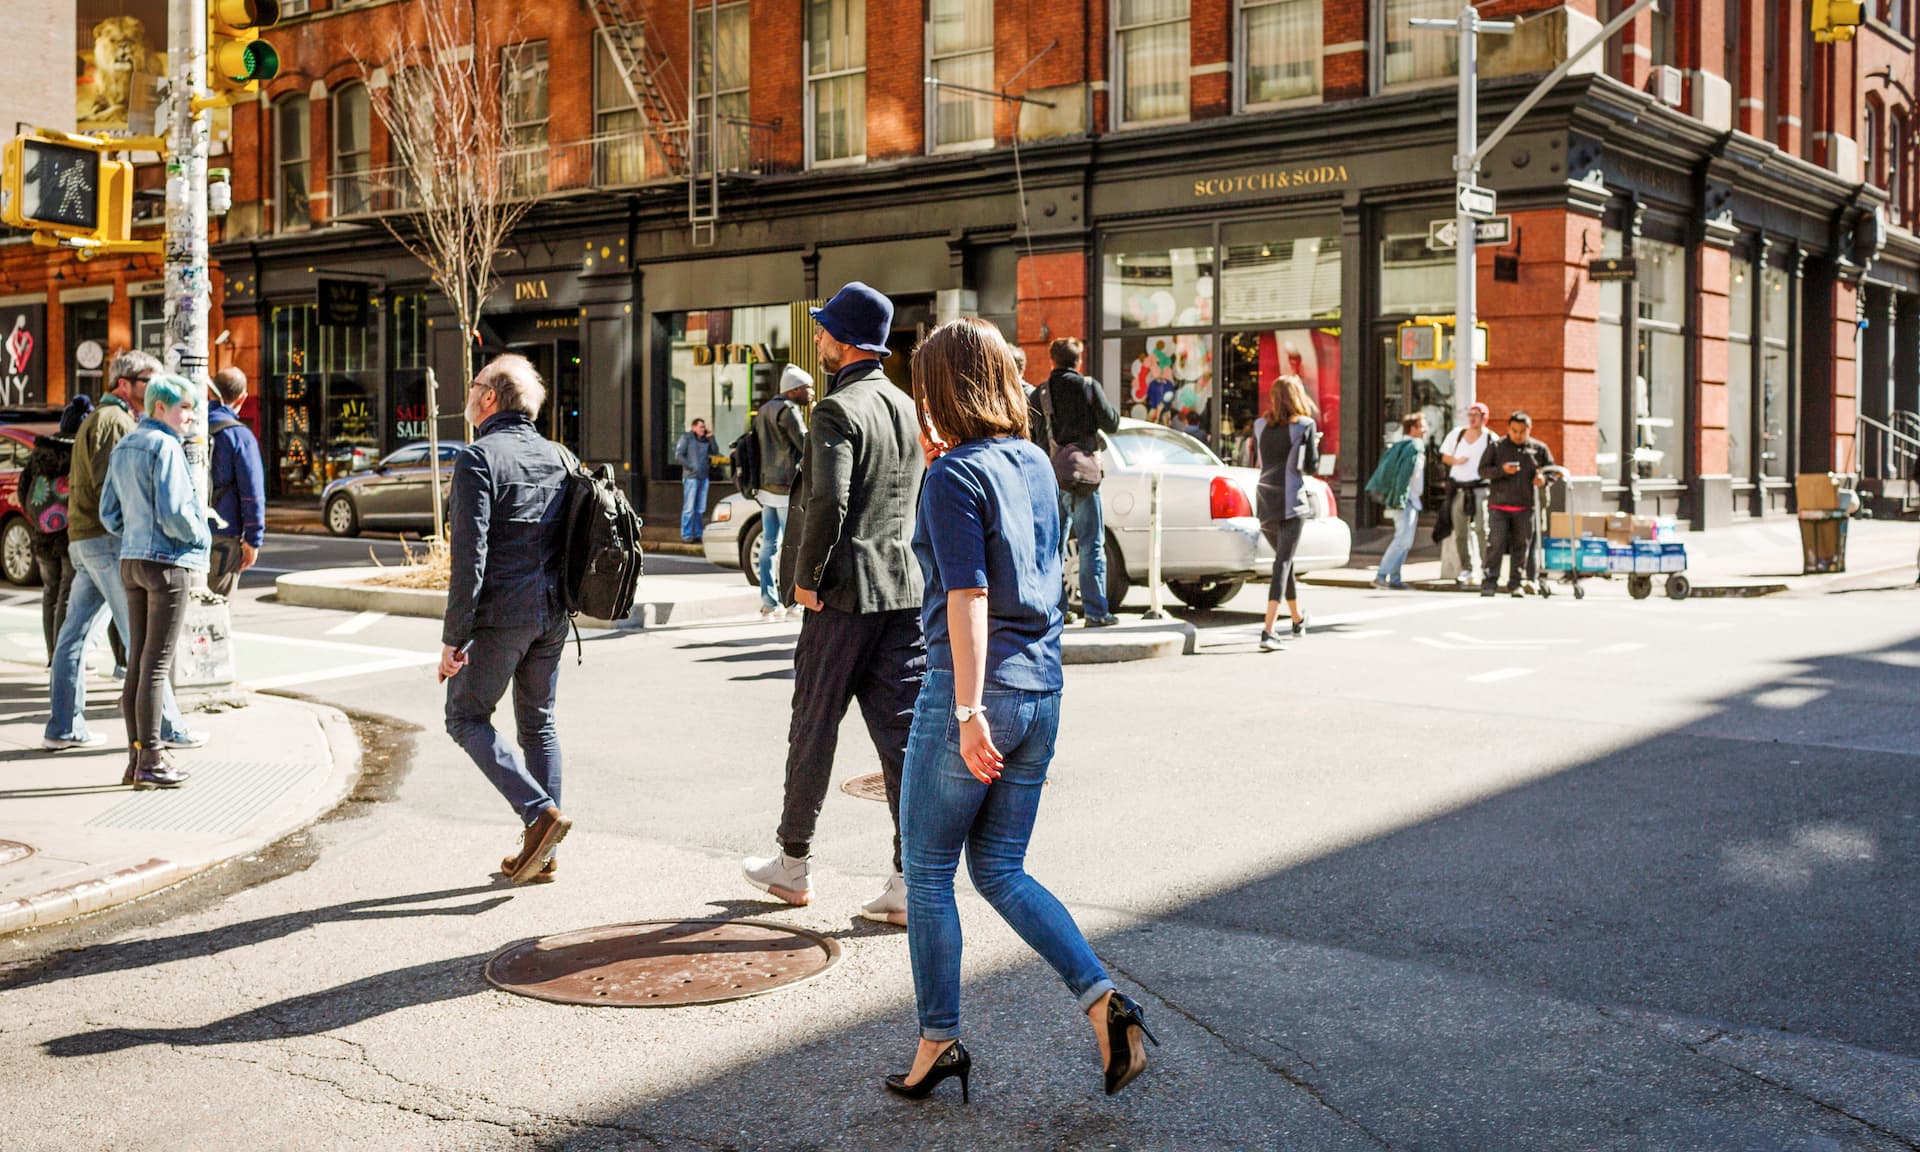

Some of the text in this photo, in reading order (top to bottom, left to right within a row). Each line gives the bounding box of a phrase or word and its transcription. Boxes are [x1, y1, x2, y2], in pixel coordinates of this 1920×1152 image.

[1194, 165, 1348, 196] SCOTCH&SODA
[515, 280, 548, 300] DNA
[693, 343, 770, 366] DITA
[286, 373, 309, 466] DNA
[396, 421, 429, 438] SALE
